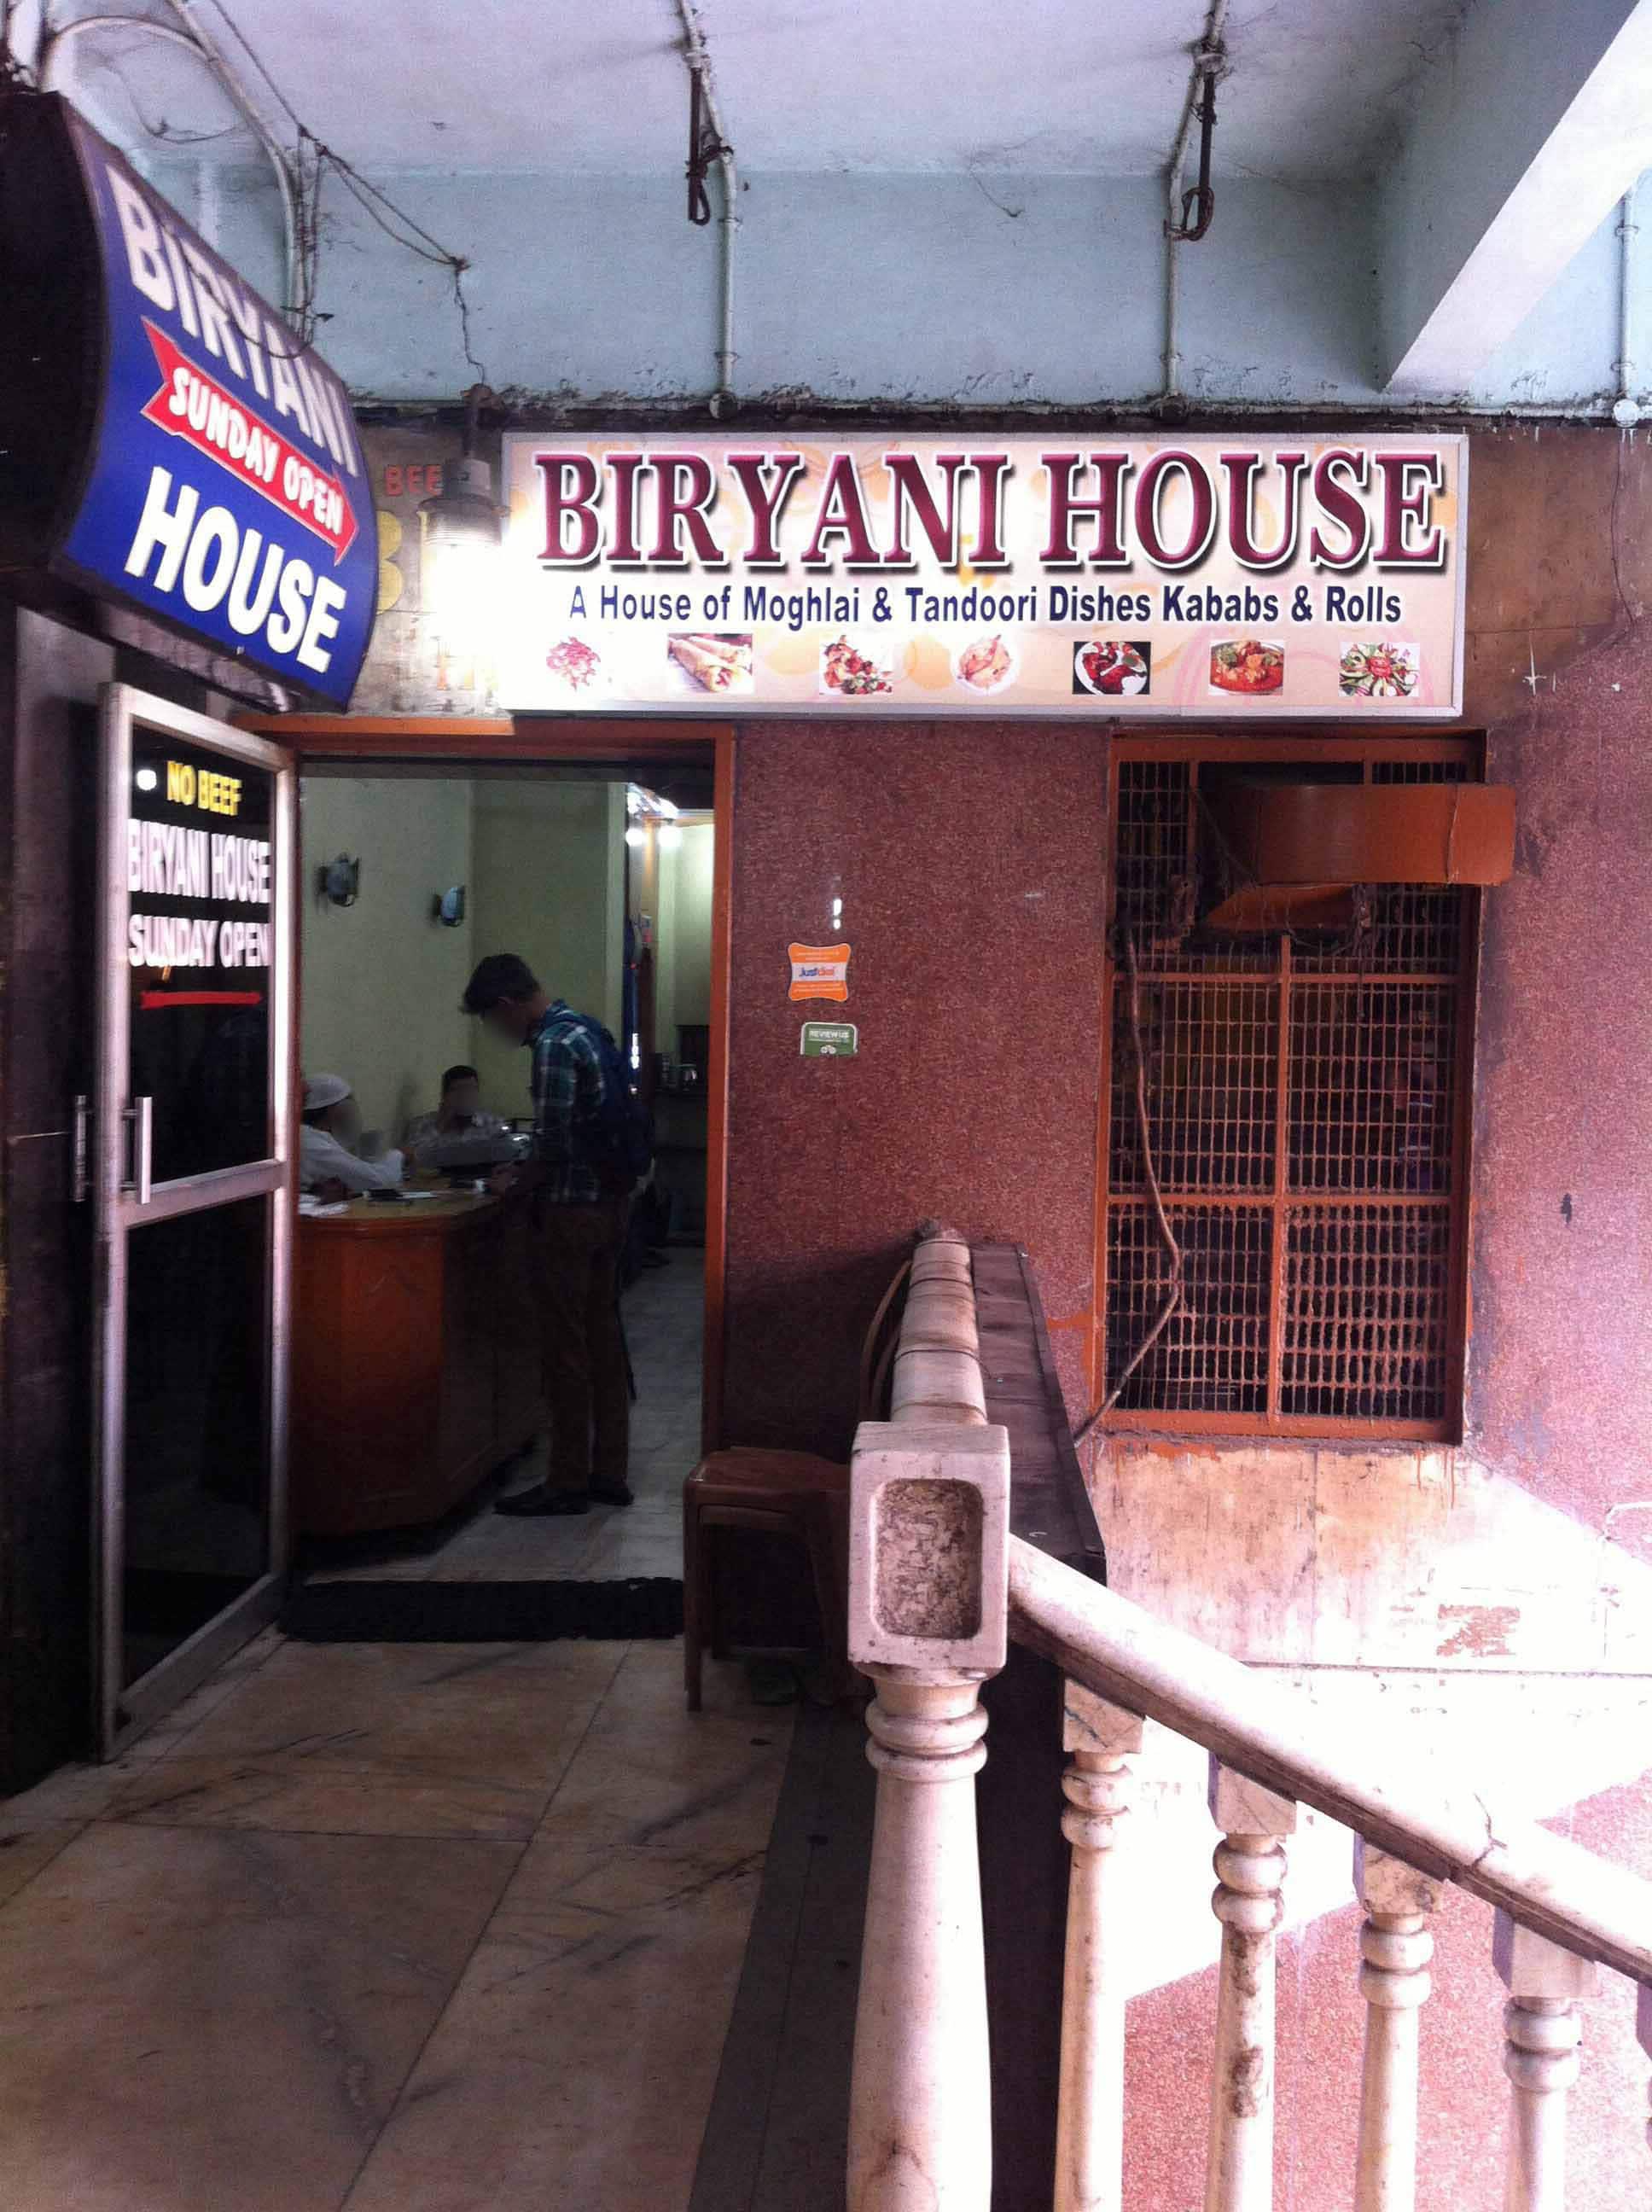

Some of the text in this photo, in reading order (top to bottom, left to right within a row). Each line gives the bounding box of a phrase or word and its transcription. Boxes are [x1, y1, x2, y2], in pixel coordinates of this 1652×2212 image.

[106, 164, 358, 477] BIRYANI
[169, 366, 343, 536] SUNDAY OPEN
[387, 464, 444, 496] BEE
[535, 454, 1008, 565] BIRYANI
[1038, 451, 1442, 565] HOUSE
[124, 466, 346, 674] HOUSE
[569, 585, 1401, 631] A House of Moghlai & Tandoori Dishes Kababs & Rolls
[167, 760, 242, 816] NO BEEF
[128, 818, 271, 904] BIRYANI HOUSE
[128, 913, 270, 968] SUNDAY OPEN
